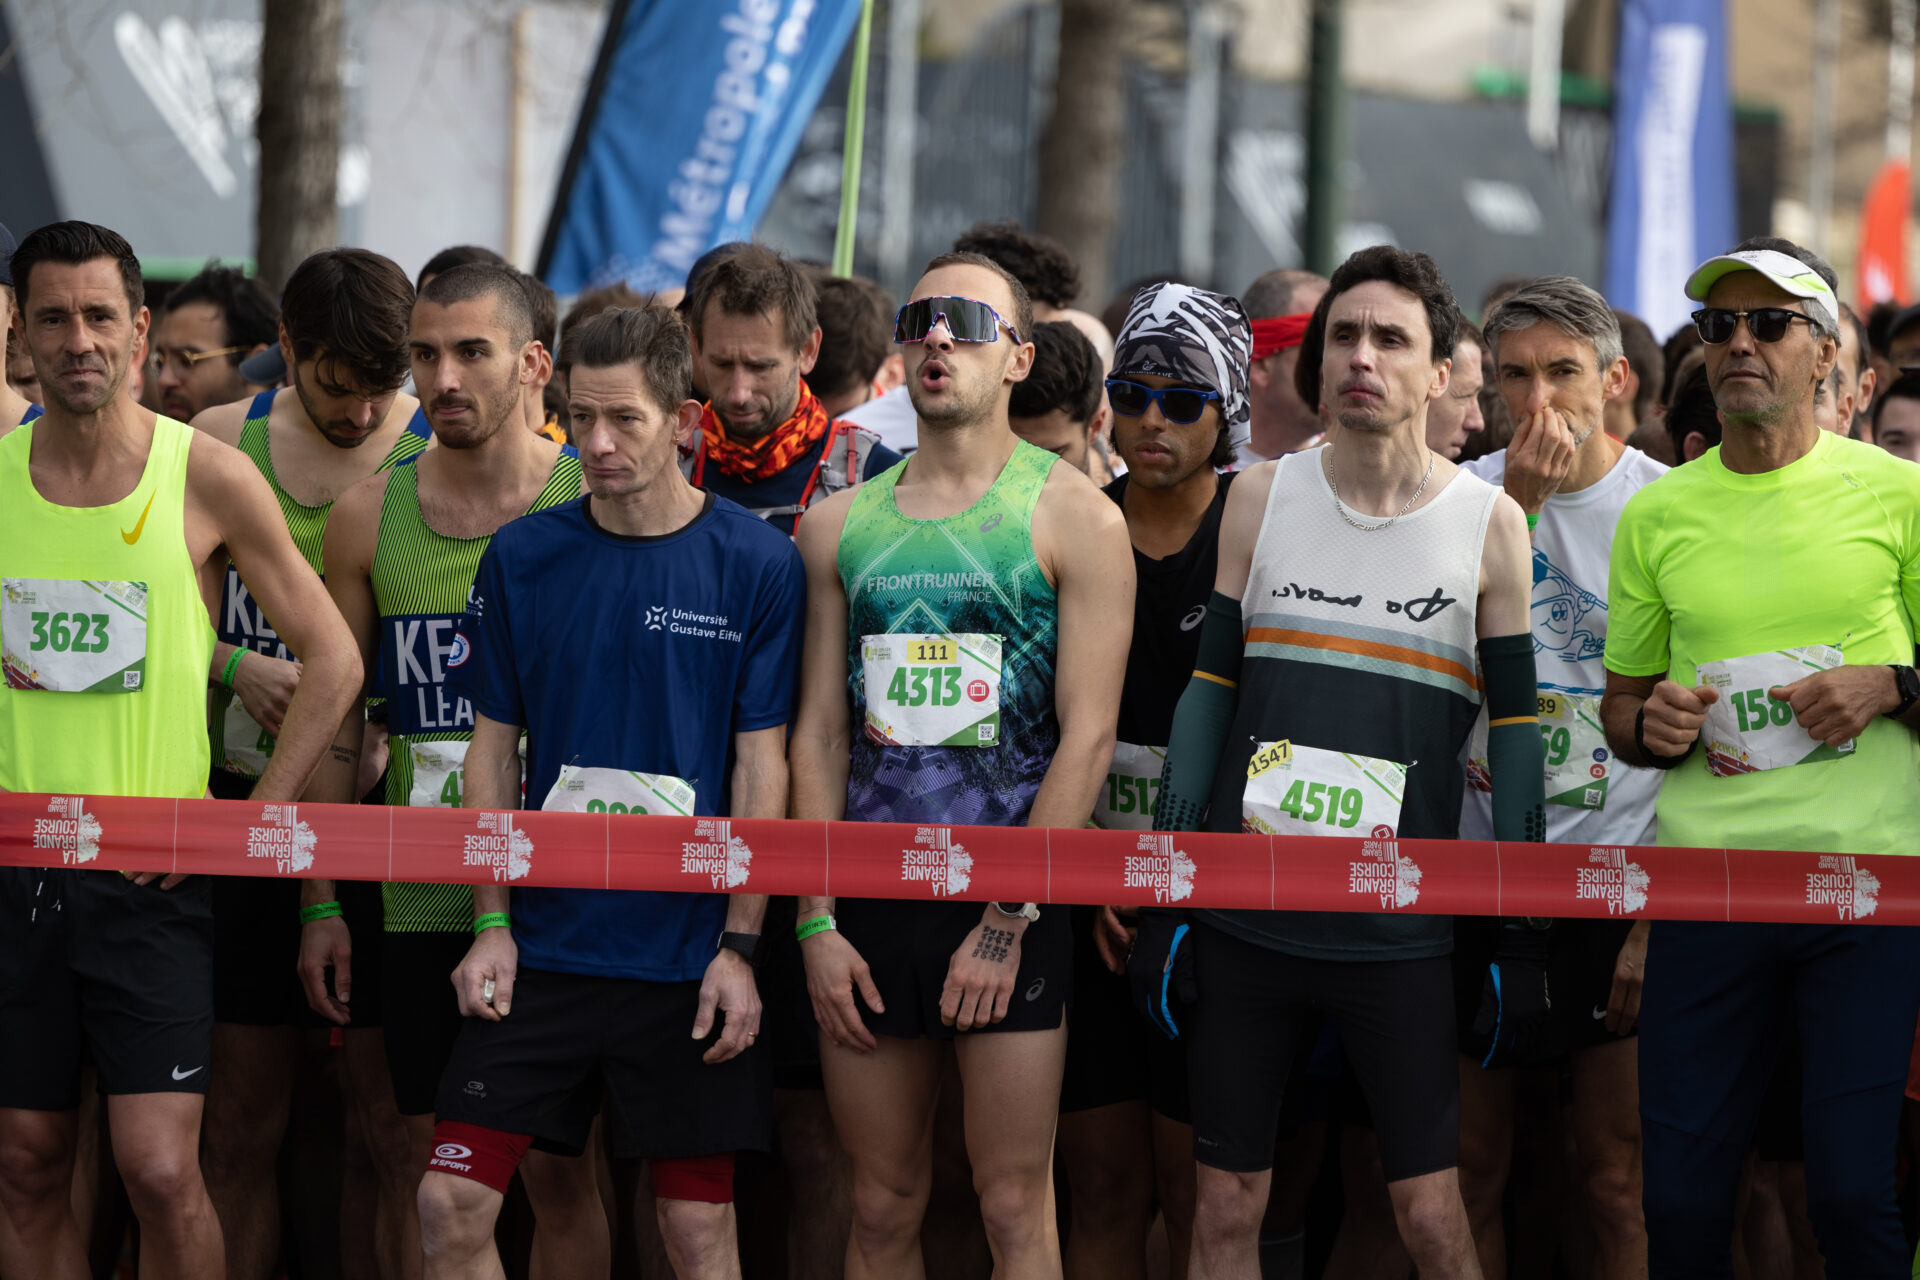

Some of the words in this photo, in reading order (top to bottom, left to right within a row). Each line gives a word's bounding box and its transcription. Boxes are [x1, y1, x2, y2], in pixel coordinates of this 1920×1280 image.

[867, 572, 994, 593] FRONTRUNNER
[947, 591, 993, 602] FRANCE
[672, 608, 728, 626] Université
[30, 611, 110, 653] 3623
[670, 622, 716, 638] Gustave
[394, 619, 462, 685] KE
[917, 644, 949, 661] 111
[887, 666, 963, 707] 4313
[1730, 684, 1795, 733] 158
[1249, 743, 1289, 775] 1547
[440, 770, 464, 809] 4
[48, 804, 67, 813] GRAND
[51, 796, 68, 805] PARIS
[264, 804, 281, 813] PARIS
[1280, 779, 1363, 828] 4519
[261, 812, 281, 821] GRAND
[477, 820, 497, 829] GRAND
[480, 812, 497, 821] PARIS
[697, 819, 715, 828] PARIS
[34, 819, 77, 834] COURSE
[694, 828, 715, 836] GRAND
[917, 827, 935, 836] PARIS
[33, 834, 76, 849] GRANDE
[248, 827, 291, 843] COURSE
[464, 834, 507, 851] COURSE
[914, 835, 935, 843] GRAND
[1139, 834, 1157, 843] PARIS
[247, 843, 291, 858] GRANDE
[681, 842, 726, 858] COURSE
[1137, 842, 1158, 851] GRAND
[1363, 840, 1382, 849] PARIS
[1590, 847, 1609, 856] PARIS
[63, 850, 76, 865] LA
[463, 850, 507, 866] GRANDE
[902, 849, 946, 865] COURSE
[1361, 849, 1383, 857] GRAND
[1588, 855, 1610, 863] GRAND
[1820, 855, 1839, 863] PARIS
[277, 859, 290, 874] LA
[681, 858, 726, 874] GRANDE
[1124, 856, 1170, 872] COURSE
[1349, 862, 1395, 878] COURSE
[1818, 861, 1840, 869] GRAND
[493, 866, 507, 882] LA
[901, 865, 946, 881] GRANDE
[1123, 871, 1169, 888] GRANDE
[1576, 867, 1622, 883] COURSE
[1806, 873, 1852, 889] COURSE
[711, 874, 725, 890] LA
[931, 881, 946, 897] LA
[1348, 877, 1395, 894] GRANDE
[1154, 888, 1169, 904] LA
[1576, 883, 1623, 899] GRANDE
[1805, 888, 1853, 905] GRANDE
[1380, 894, 1395, 910] LA
[1607, 900, 1622, 915] LA
[1837, 905, 1852, 920] LA
[438, 1160, 472, 1172] SPORT
